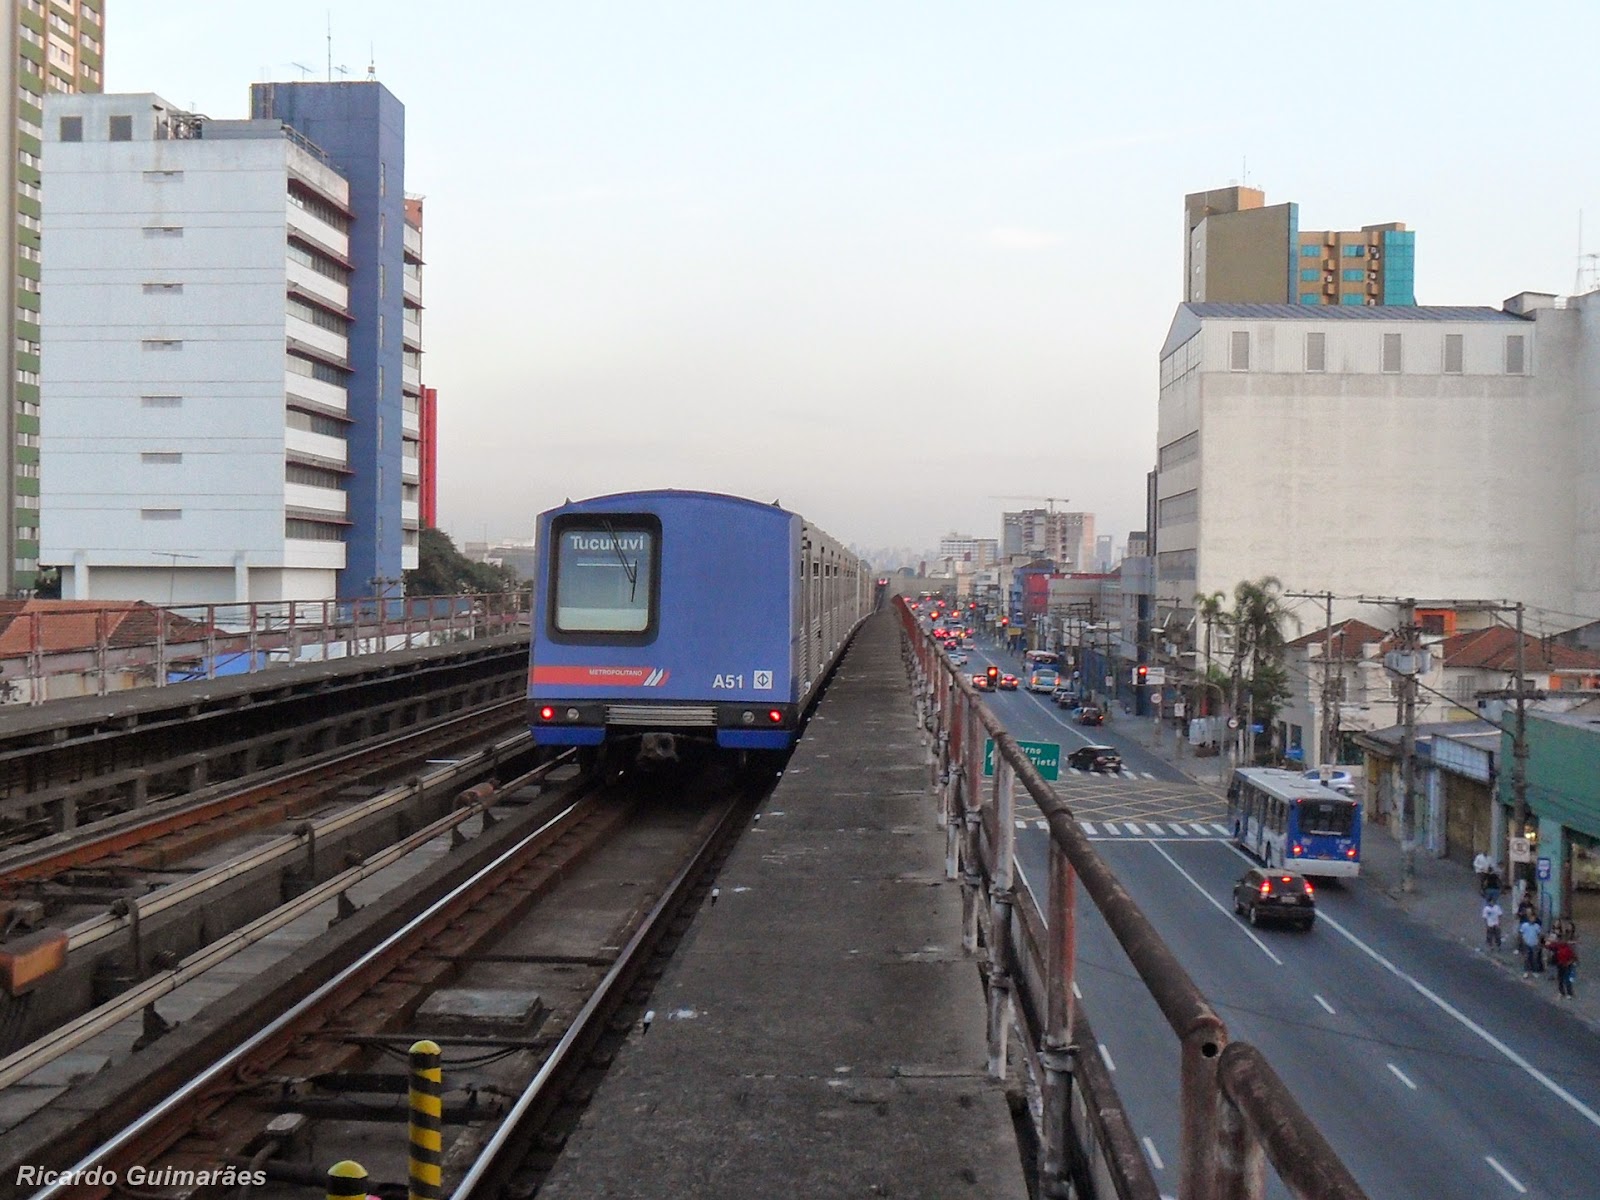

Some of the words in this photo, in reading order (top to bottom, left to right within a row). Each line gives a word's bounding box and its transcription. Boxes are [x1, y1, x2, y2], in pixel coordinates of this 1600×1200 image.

[570, 535, 644, 551] Tucuruvi
[589, 669, 643, 677] METROPOLITANO
[712, 674, 744, 689] A51
